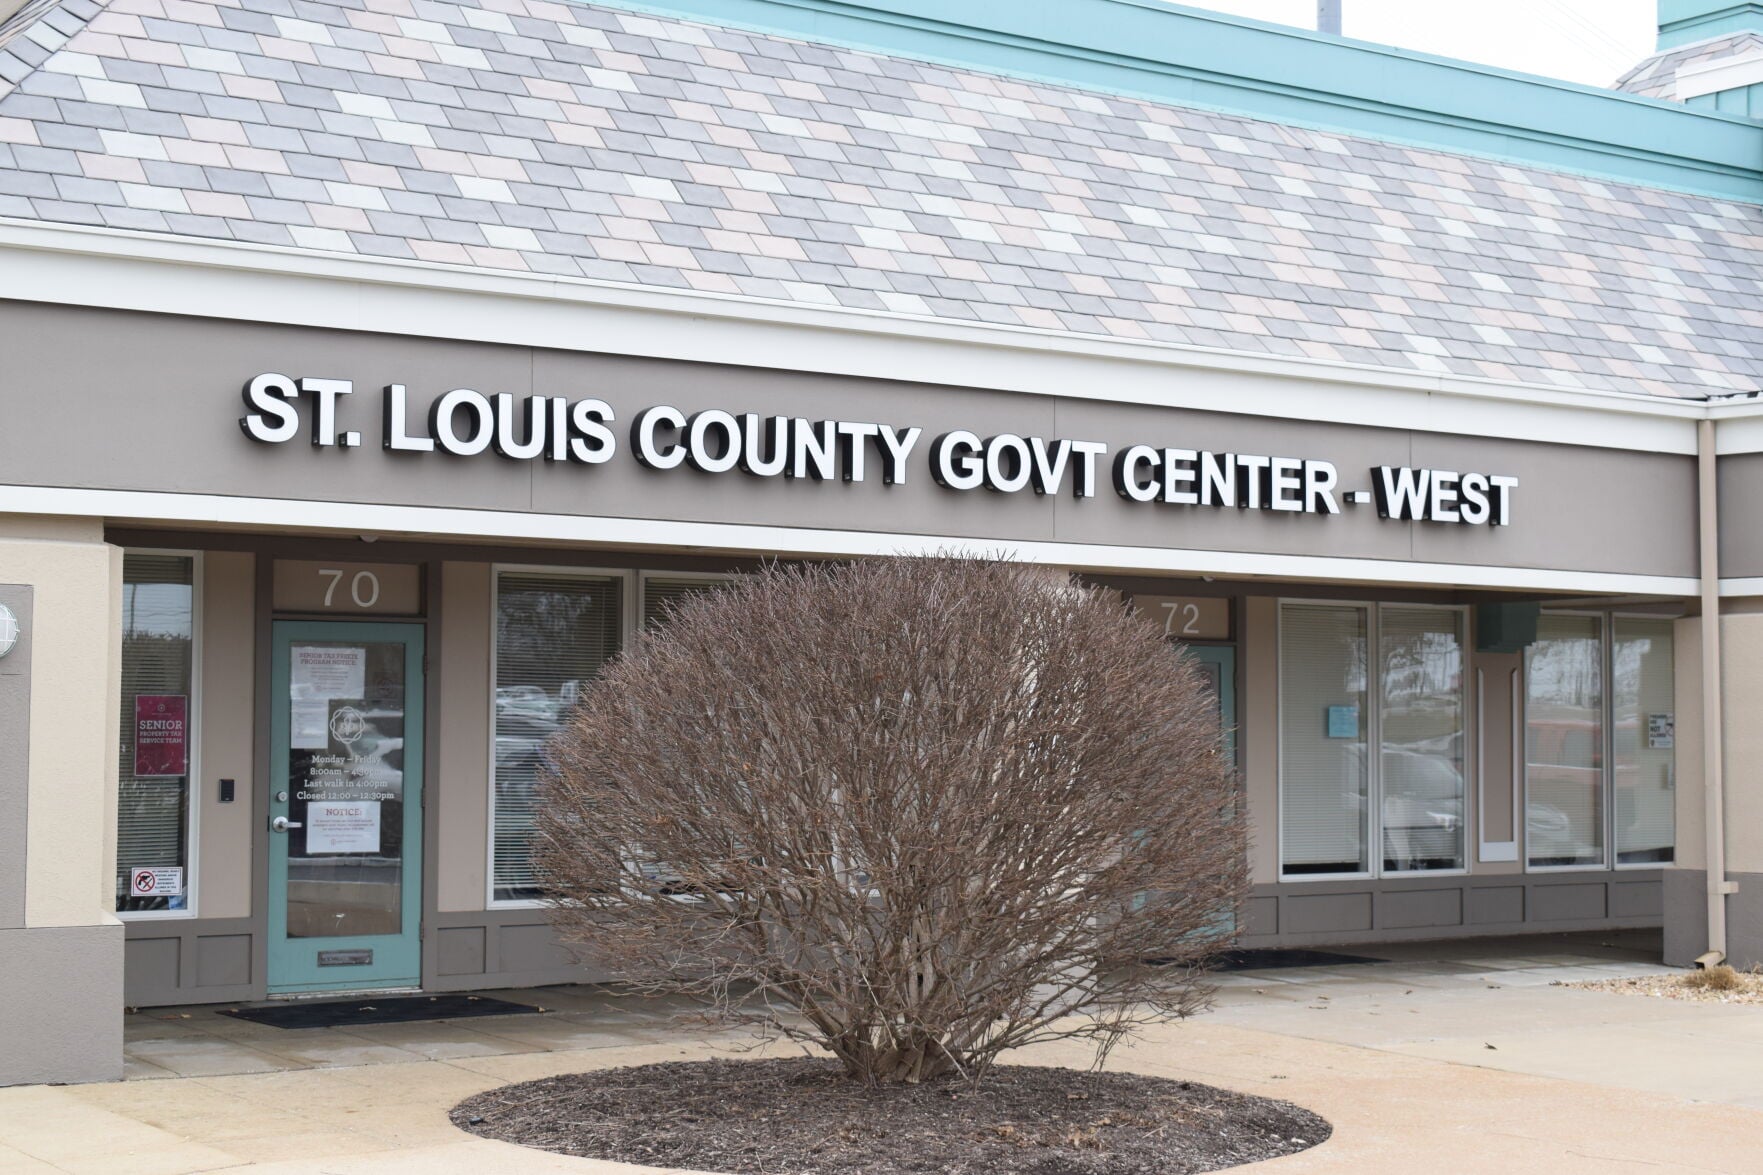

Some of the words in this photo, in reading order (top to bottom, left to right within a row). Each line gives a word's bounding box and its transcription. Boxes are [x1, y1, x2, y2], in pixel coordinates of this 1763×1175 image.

[242, 372, 361, 448] ST.
[384, 383, 617, 464] LOUIS
[632, 405, 922, 485] COUNTY
[931, 429, 1108, 498] GOVT
[1114, 444, 1340, 514] CENTER
[1372, 465, 1519, 527] WEST
[318, 568, 380, 608] 70
[1160, 602, 1199, 636] 72
[139, 720, 183, 730] SENIOR
[311, 754, 345, 765] Monday
[355, 754, 381, 765] Friday
[310, 767, 342, 776] 8:00am
[304, 779, 322, 788] Last
[324, 779, 344, 788] walk
[345, 779, 354, 788] in
[355, 780, 388, 789] 4:00pm
[296, 790, 326, 800] Closed
[328, 792, 351, 800] 12:00
[360, 792, 395, 801] 12:30pm
